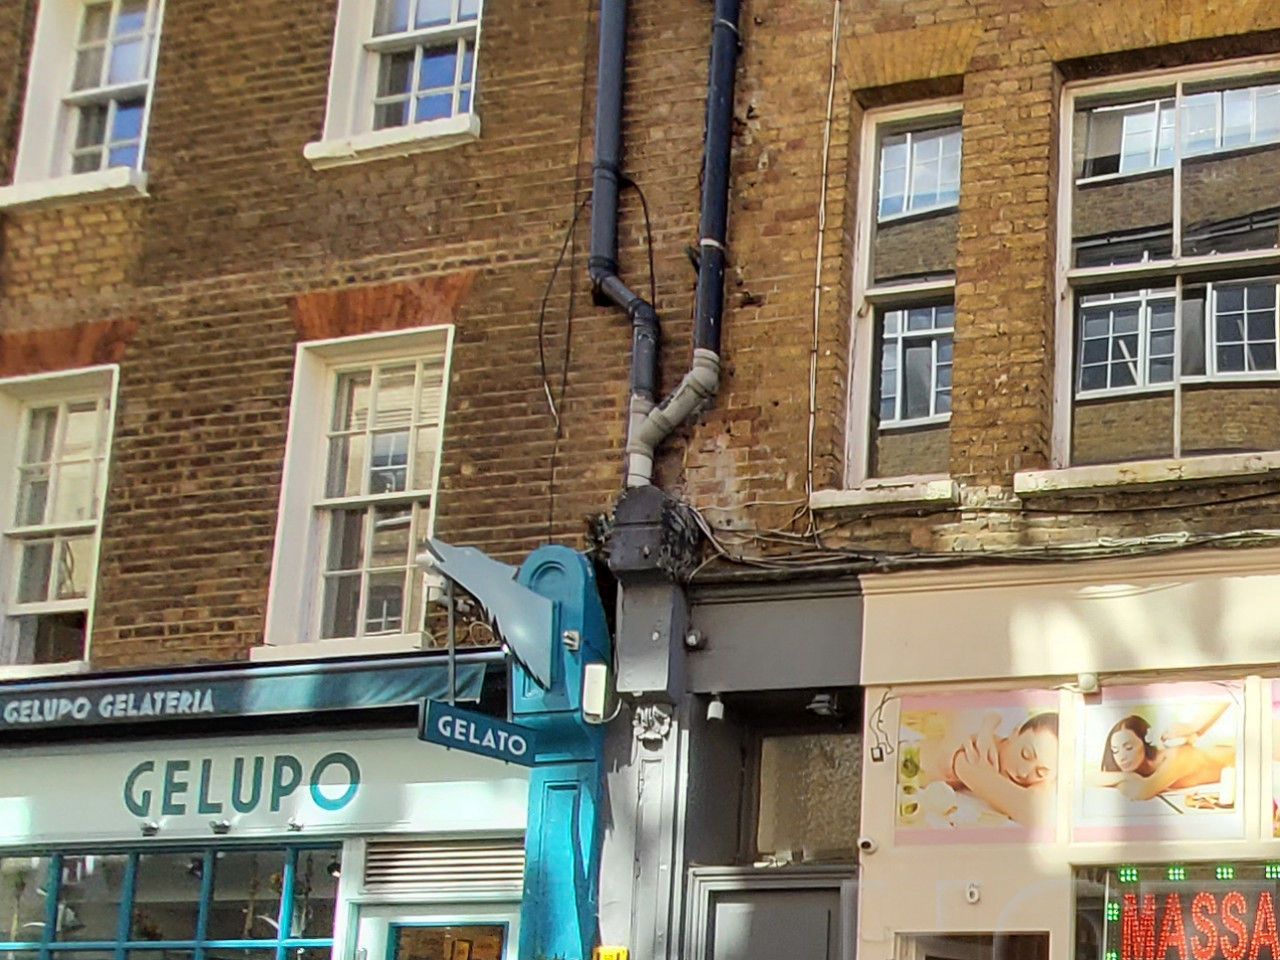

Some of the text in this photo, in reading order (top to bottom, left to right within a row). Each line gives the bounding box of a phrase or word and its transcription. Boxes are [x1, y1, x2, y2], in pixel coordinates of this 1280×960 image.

[3, 689, 214, 723] GELUPO GELATERIA
[438, 716, 527, 755] GELATO
[124, 752, 361, 818] GELUPO
[966, 880, 979, 903] 6
